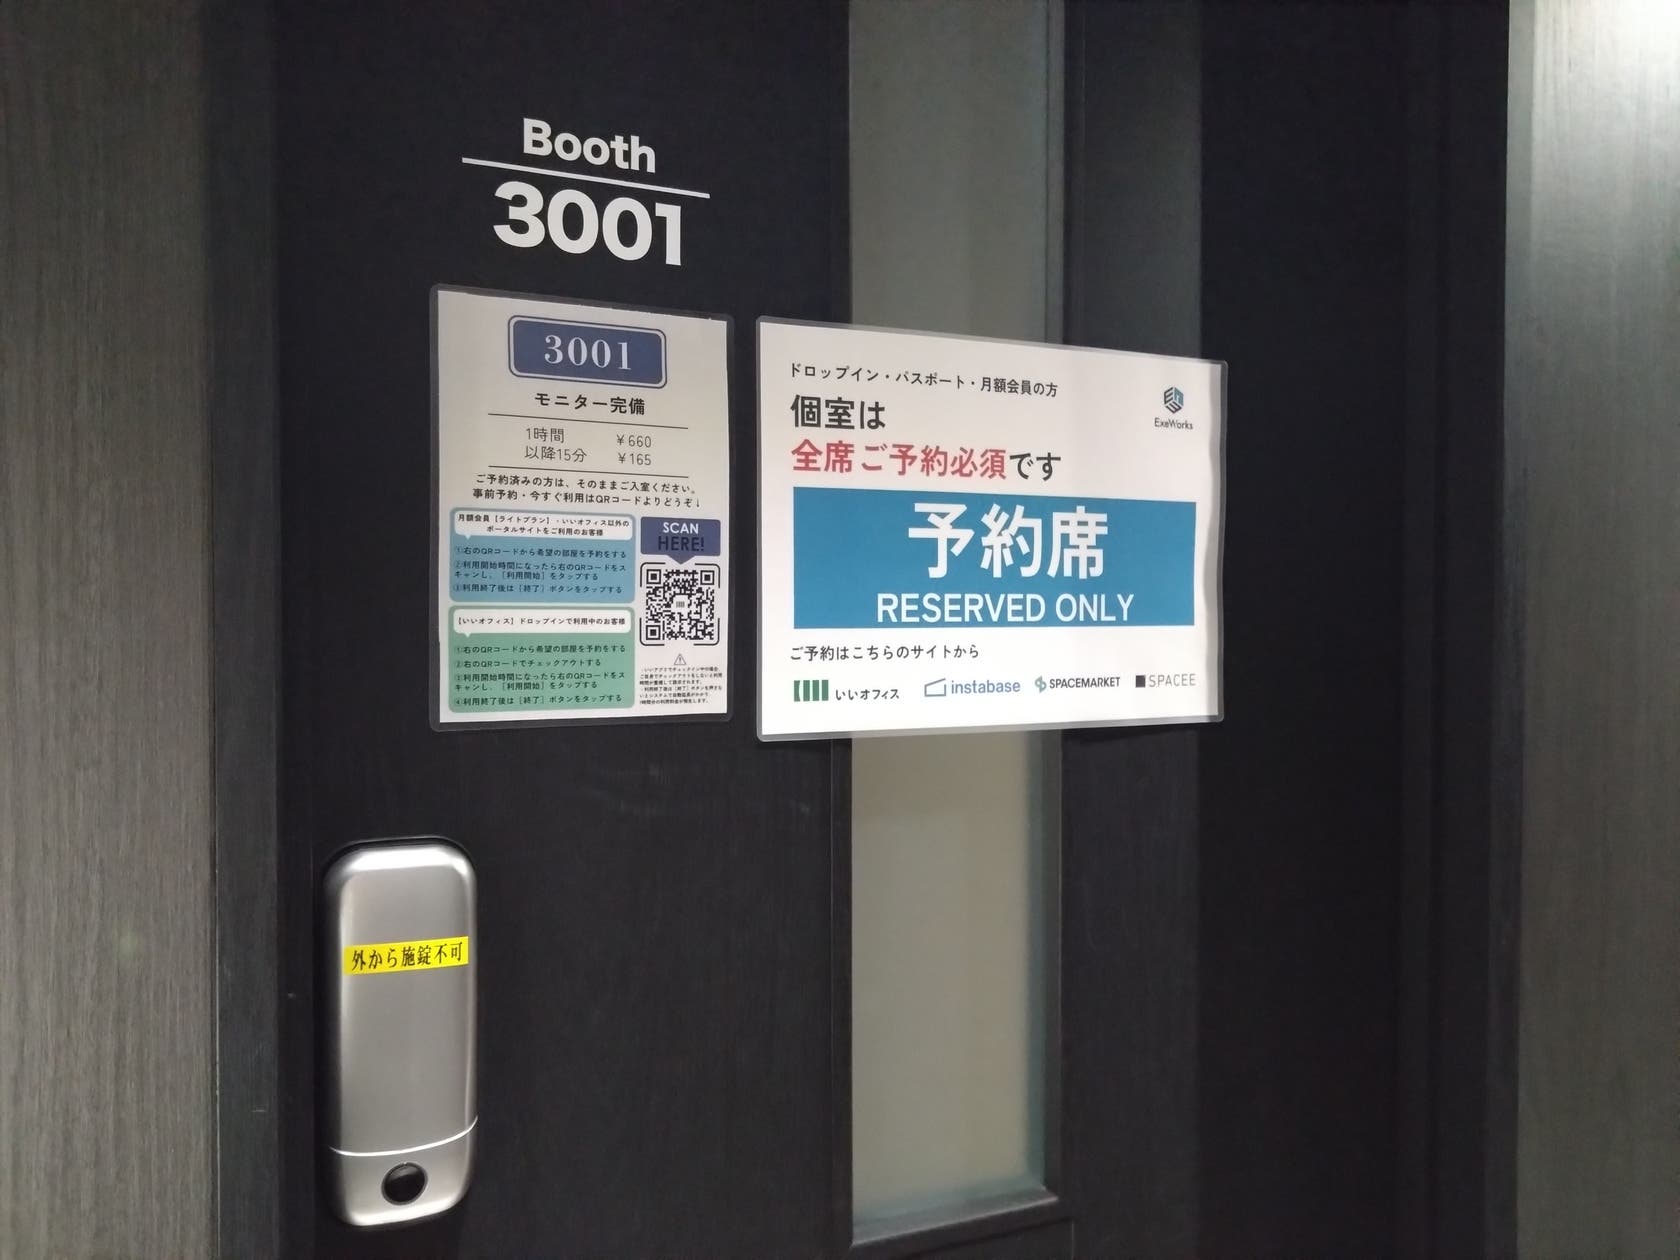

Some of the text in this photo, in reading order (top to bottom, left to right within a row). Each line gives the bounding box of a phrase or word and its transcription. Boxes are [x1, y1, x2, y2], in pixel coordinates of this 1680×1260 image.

[523, 117, 656, 173] Booth
[493, 181, 681, 266] 3001
[544, 334, 631, 370] 3001
[790, 362, 1058, 398] ドロップイン・パスポート・月額会員の方
[534, 392, 646, 416] モニター完備
[790, 394, 886, 430] 個室は
[1154, 417, 1193, 430] ExeWorks
[526, 427, 565, 444] 1時間
[524, 446, 587, 463] 以降15分
[662, 522, 699, 535] SCAN
[658, 535, 705, 552] HERE!
[908, 502, 1109, 579] 予約席
[877, 593, 1134, 623] RESERVED ONLY
[790, 643, 980, 661] ご予約はこちらのサイトから
[951, 679, 1021, 695] instabase
[1049, 676, 1121, 690] SPACEMARKET
[1148, 673, 1197, 688] SPACEE
[835, 687, 900, 702] いいオフィス
[353, 943, 463, 970] 外から施錠不可
